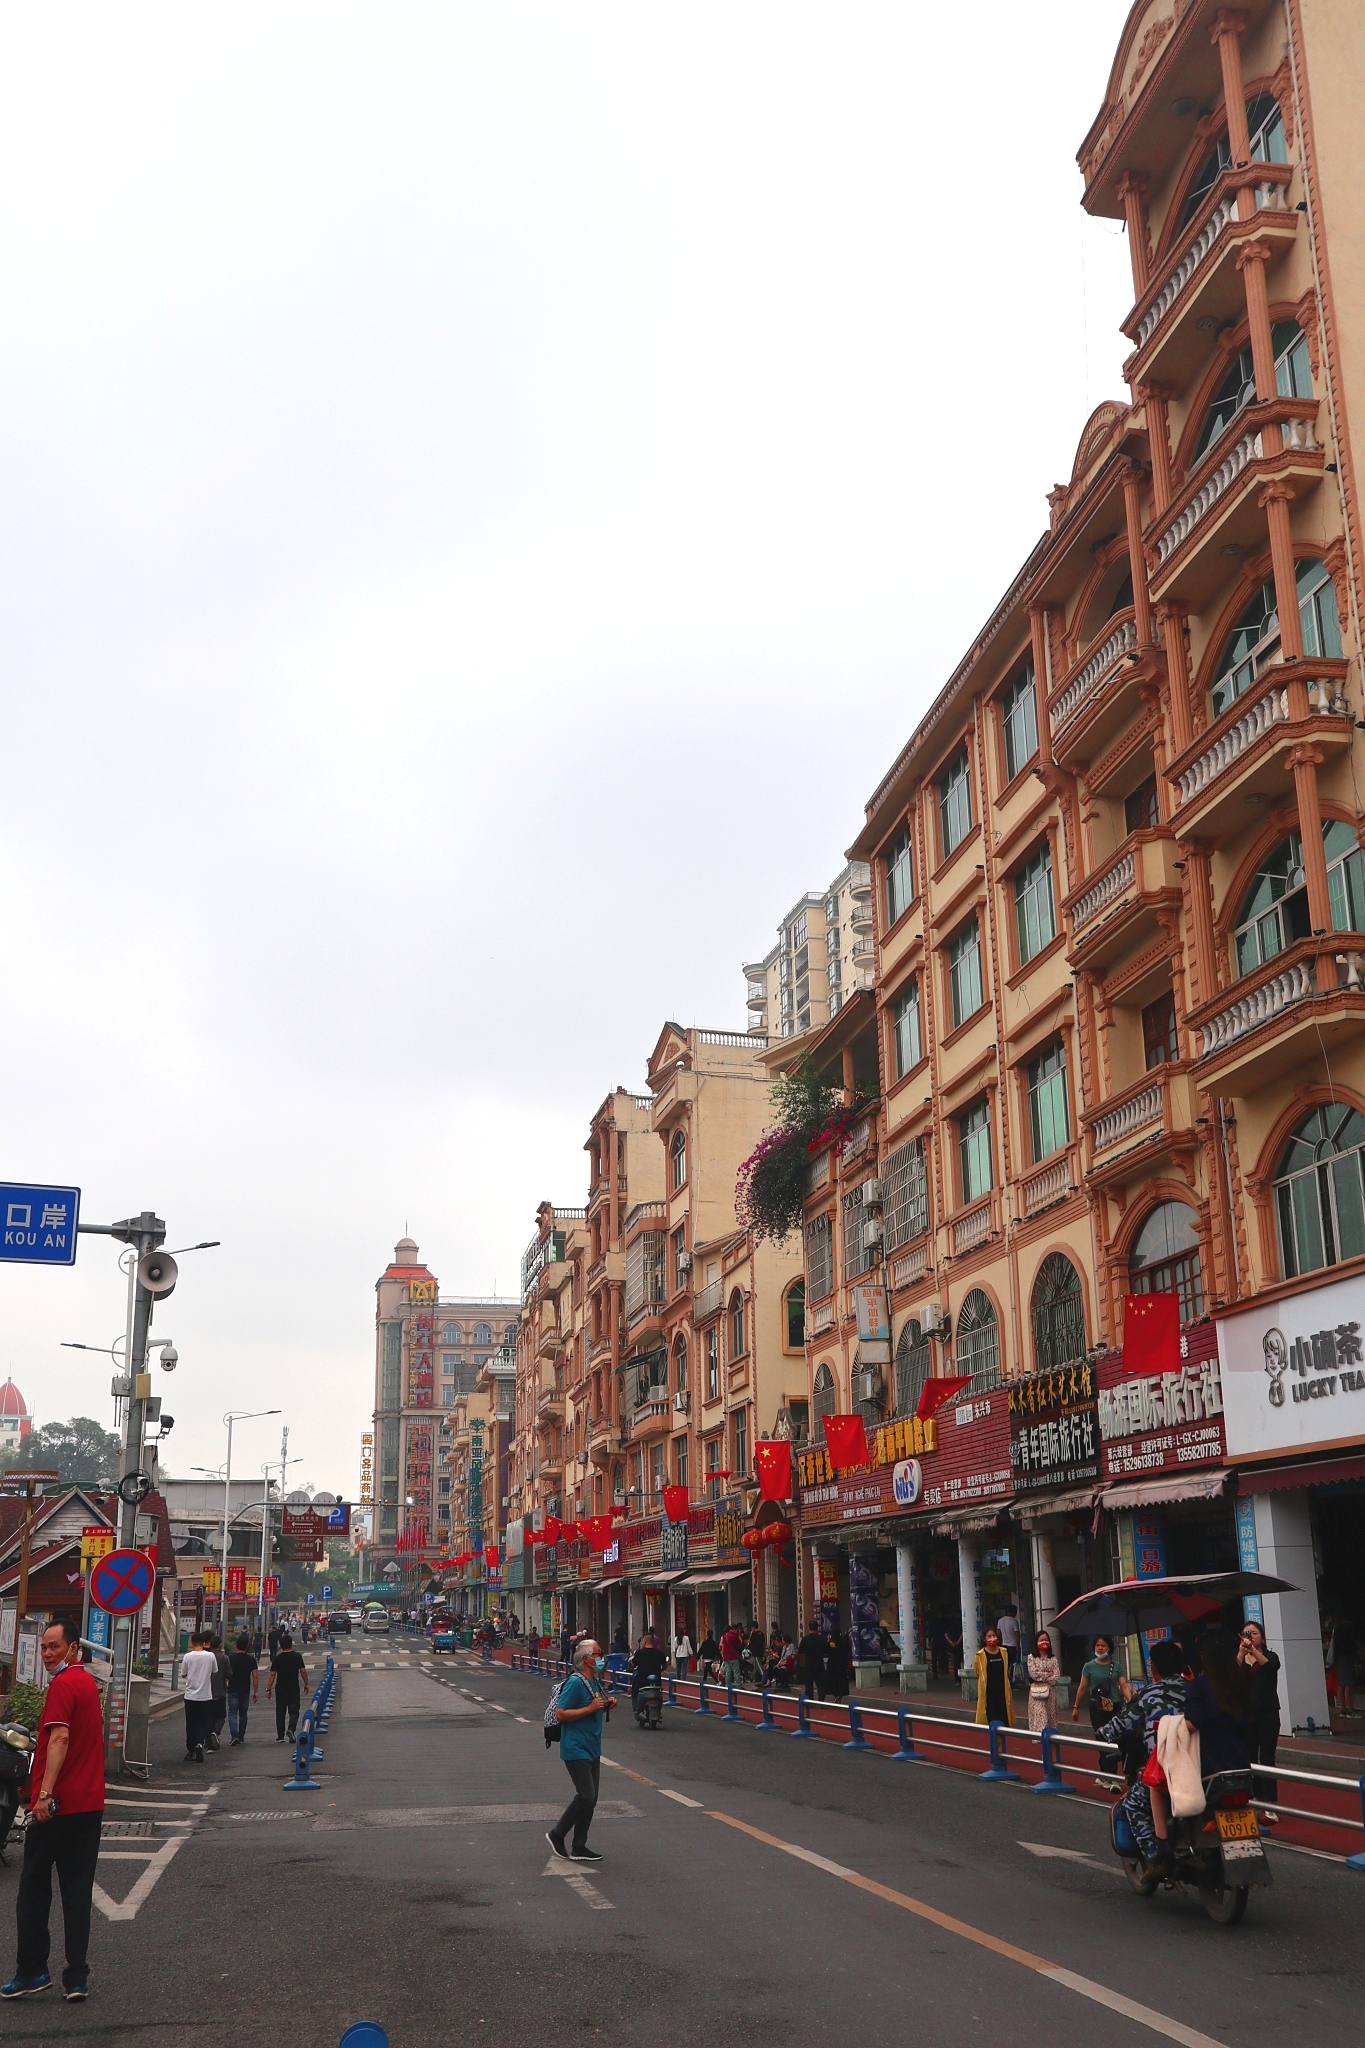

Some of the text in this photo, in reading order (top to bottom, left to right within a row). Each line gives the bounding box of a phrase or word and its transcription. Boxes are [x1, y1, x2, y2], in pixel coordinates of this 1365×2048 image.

[6, 1203, 67, 1229] 口岸
[5, 1231, 66, 1248] KOU AN
[417, 1313, 434, 1408] 国门大酒店
[1098, 1359, 1223, 1440] 畅游国际旅行社
[1292, 1369, 1365, 1402] LUCKY TEA
[1019, 1411, 1095, 1471] 青年国际旅行社
[1107, 1444, 1133, 1461] 第六经营部
[924, 1487, 941, 1505] 专卖店
[821, 1561, 838, 1598] 香烟
[92, 1611, 105, 1646] 行李寄
[1222, 1822, 1257, 1838] V0916
